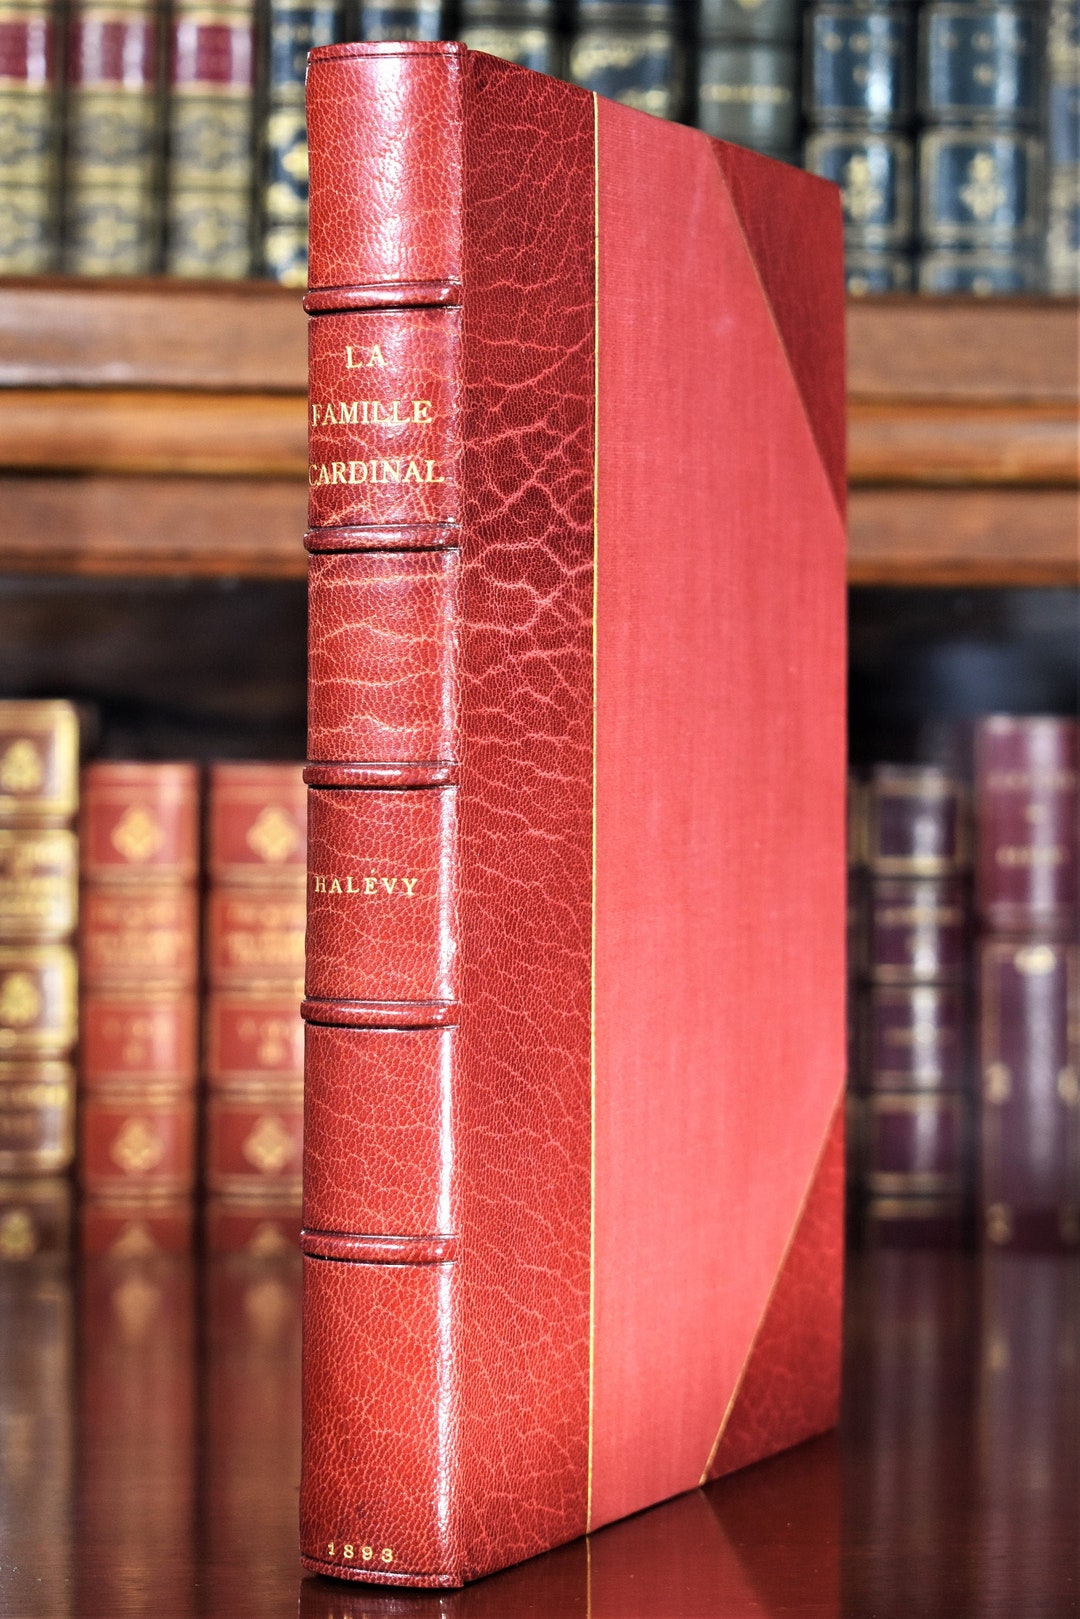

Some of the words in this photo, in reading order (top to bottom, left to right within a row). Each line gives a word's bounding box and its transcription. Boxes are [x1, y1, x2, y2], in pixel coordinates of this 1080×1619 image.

[345, 344, 387, 369] LA
[311, 400, 433, 427] FAMILLE
[308, 459, 445, 486] CARDINAL
[314, 868, 419, 896] HALÉVY
[327, 1541, 394, 1563] 1893
